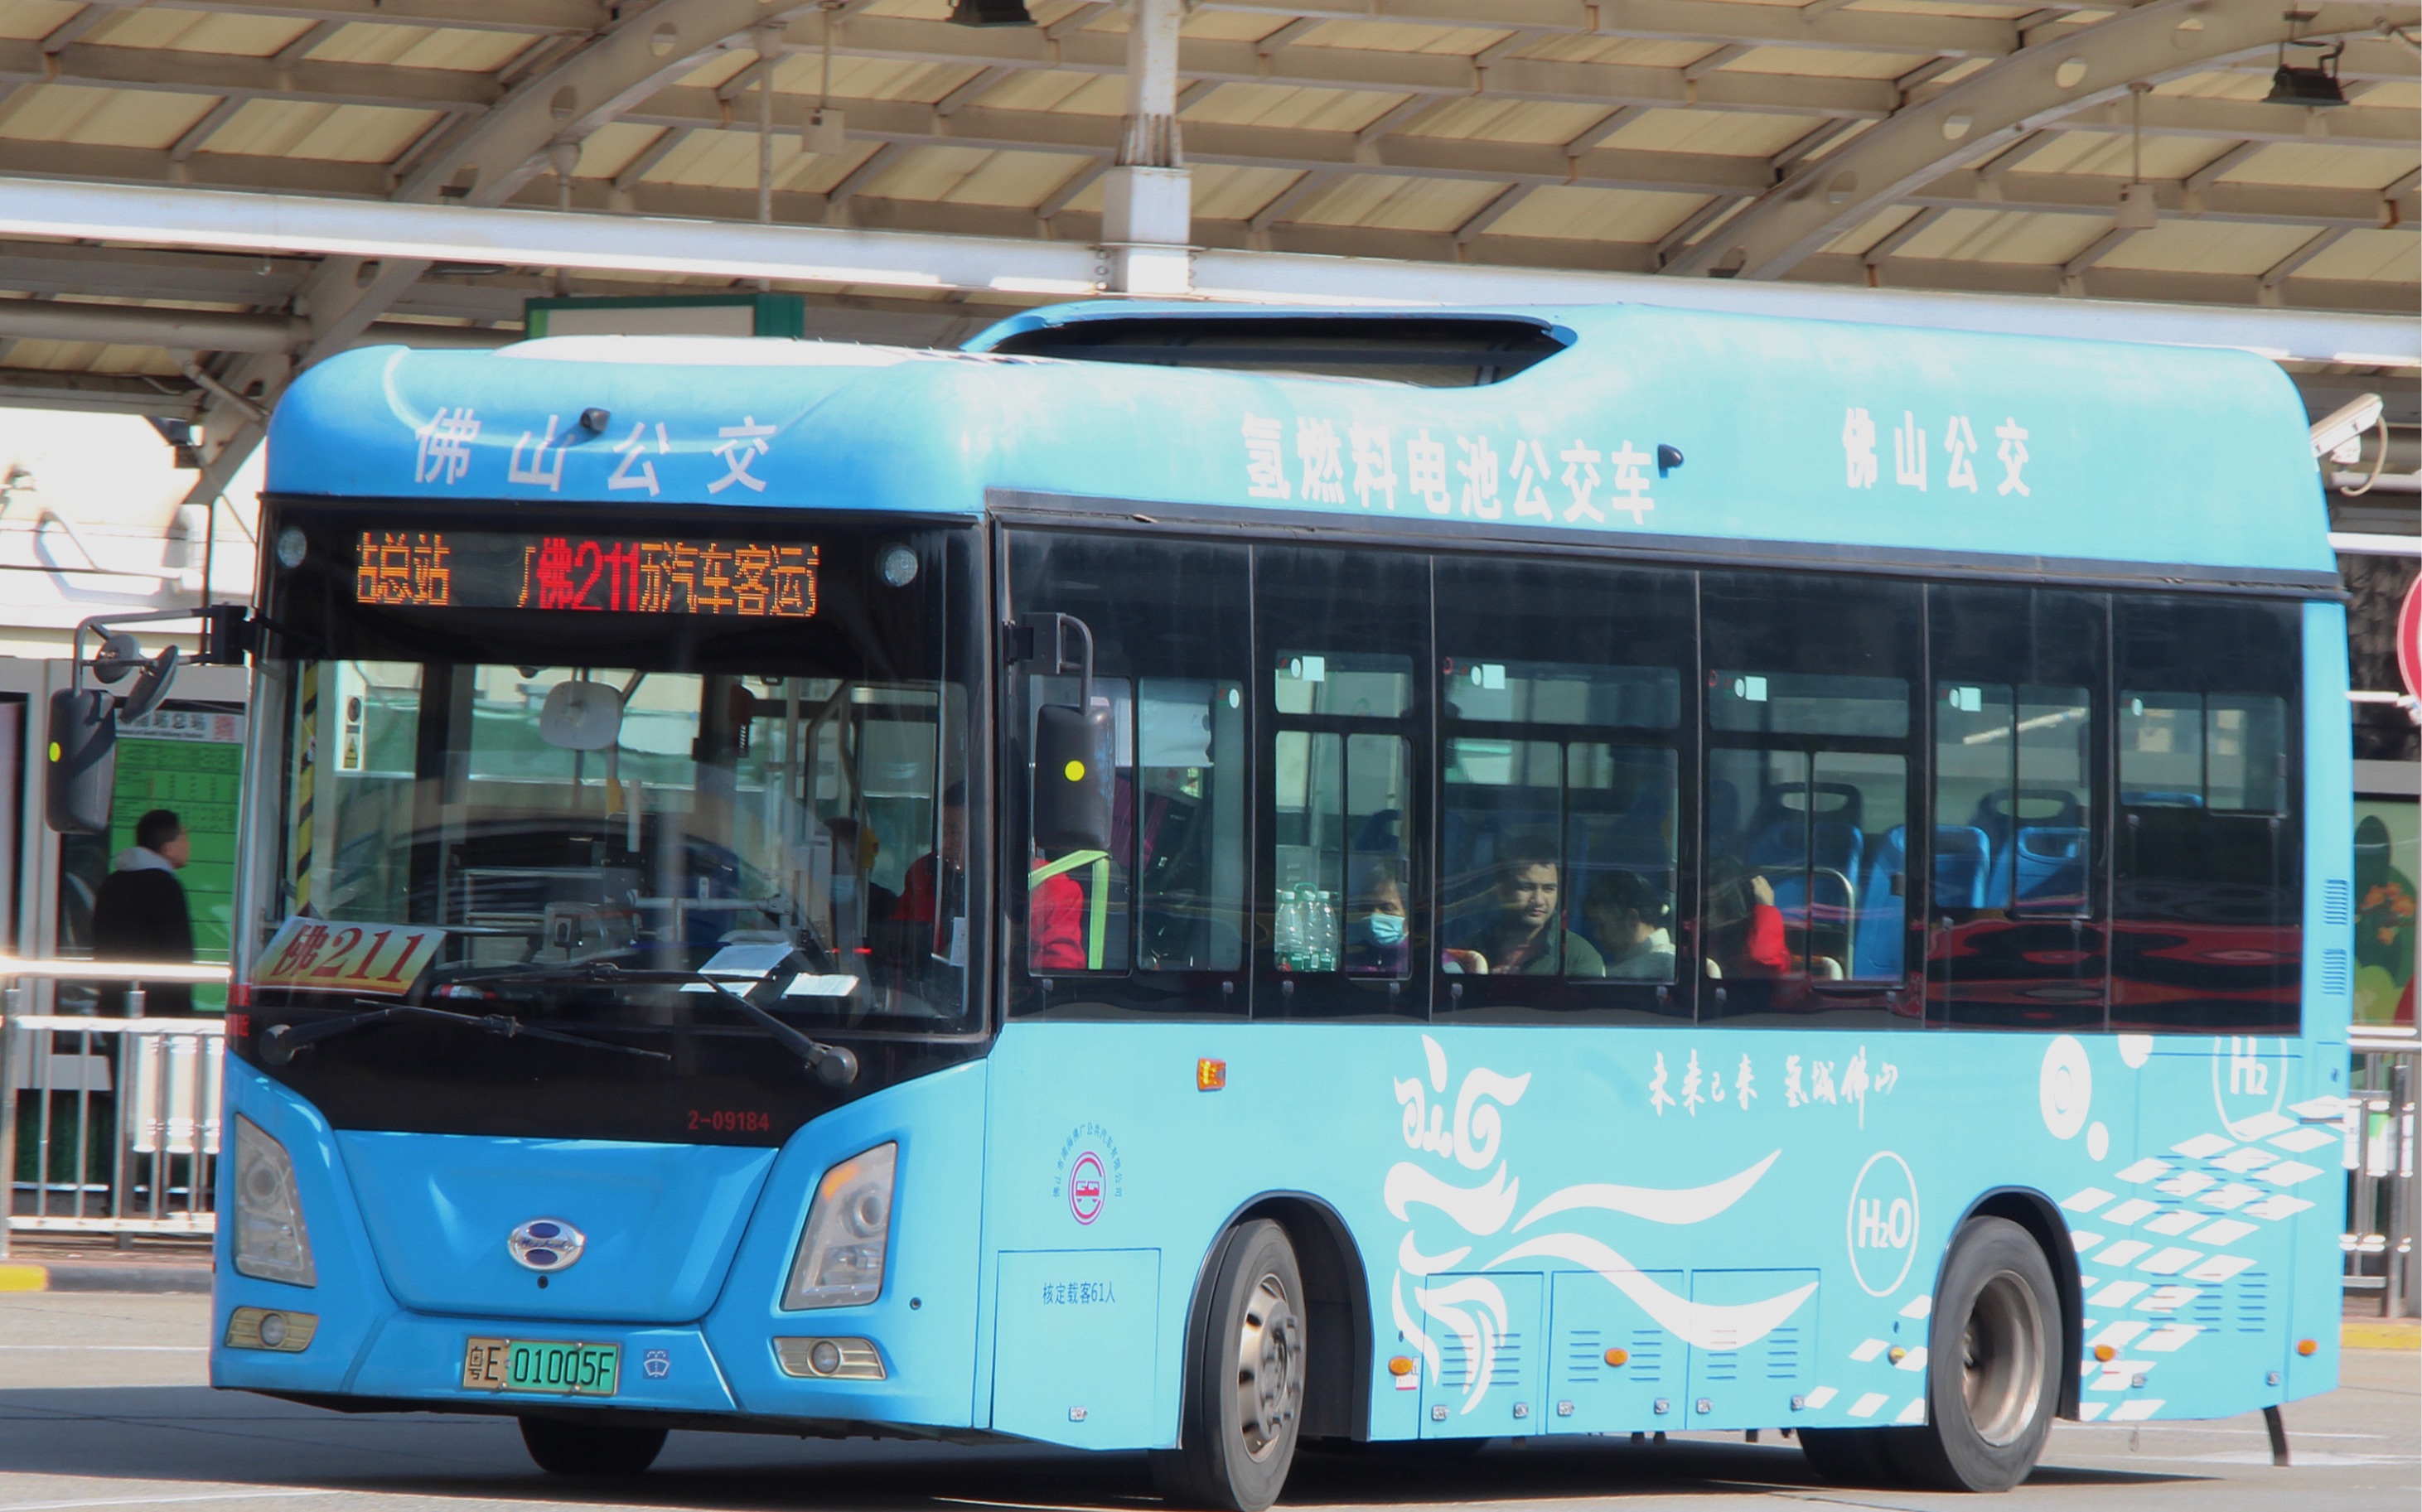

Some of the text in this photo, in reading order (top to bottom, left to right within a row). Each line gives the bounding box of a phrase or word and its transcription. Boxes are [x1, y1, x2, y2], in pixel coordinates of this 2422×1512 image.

[414, 407, 777, 497] 佛山公交
[1241, 411, 1656, 525] 氢燃料电池公交车
[1841, 407, 2030, 497] 佛山公交
[270, 924, 425, 983] 佛211
[689, 1110, 770, 1132] 2-09184
[1042, 1282, 1116, 1306] 核定载客61人
